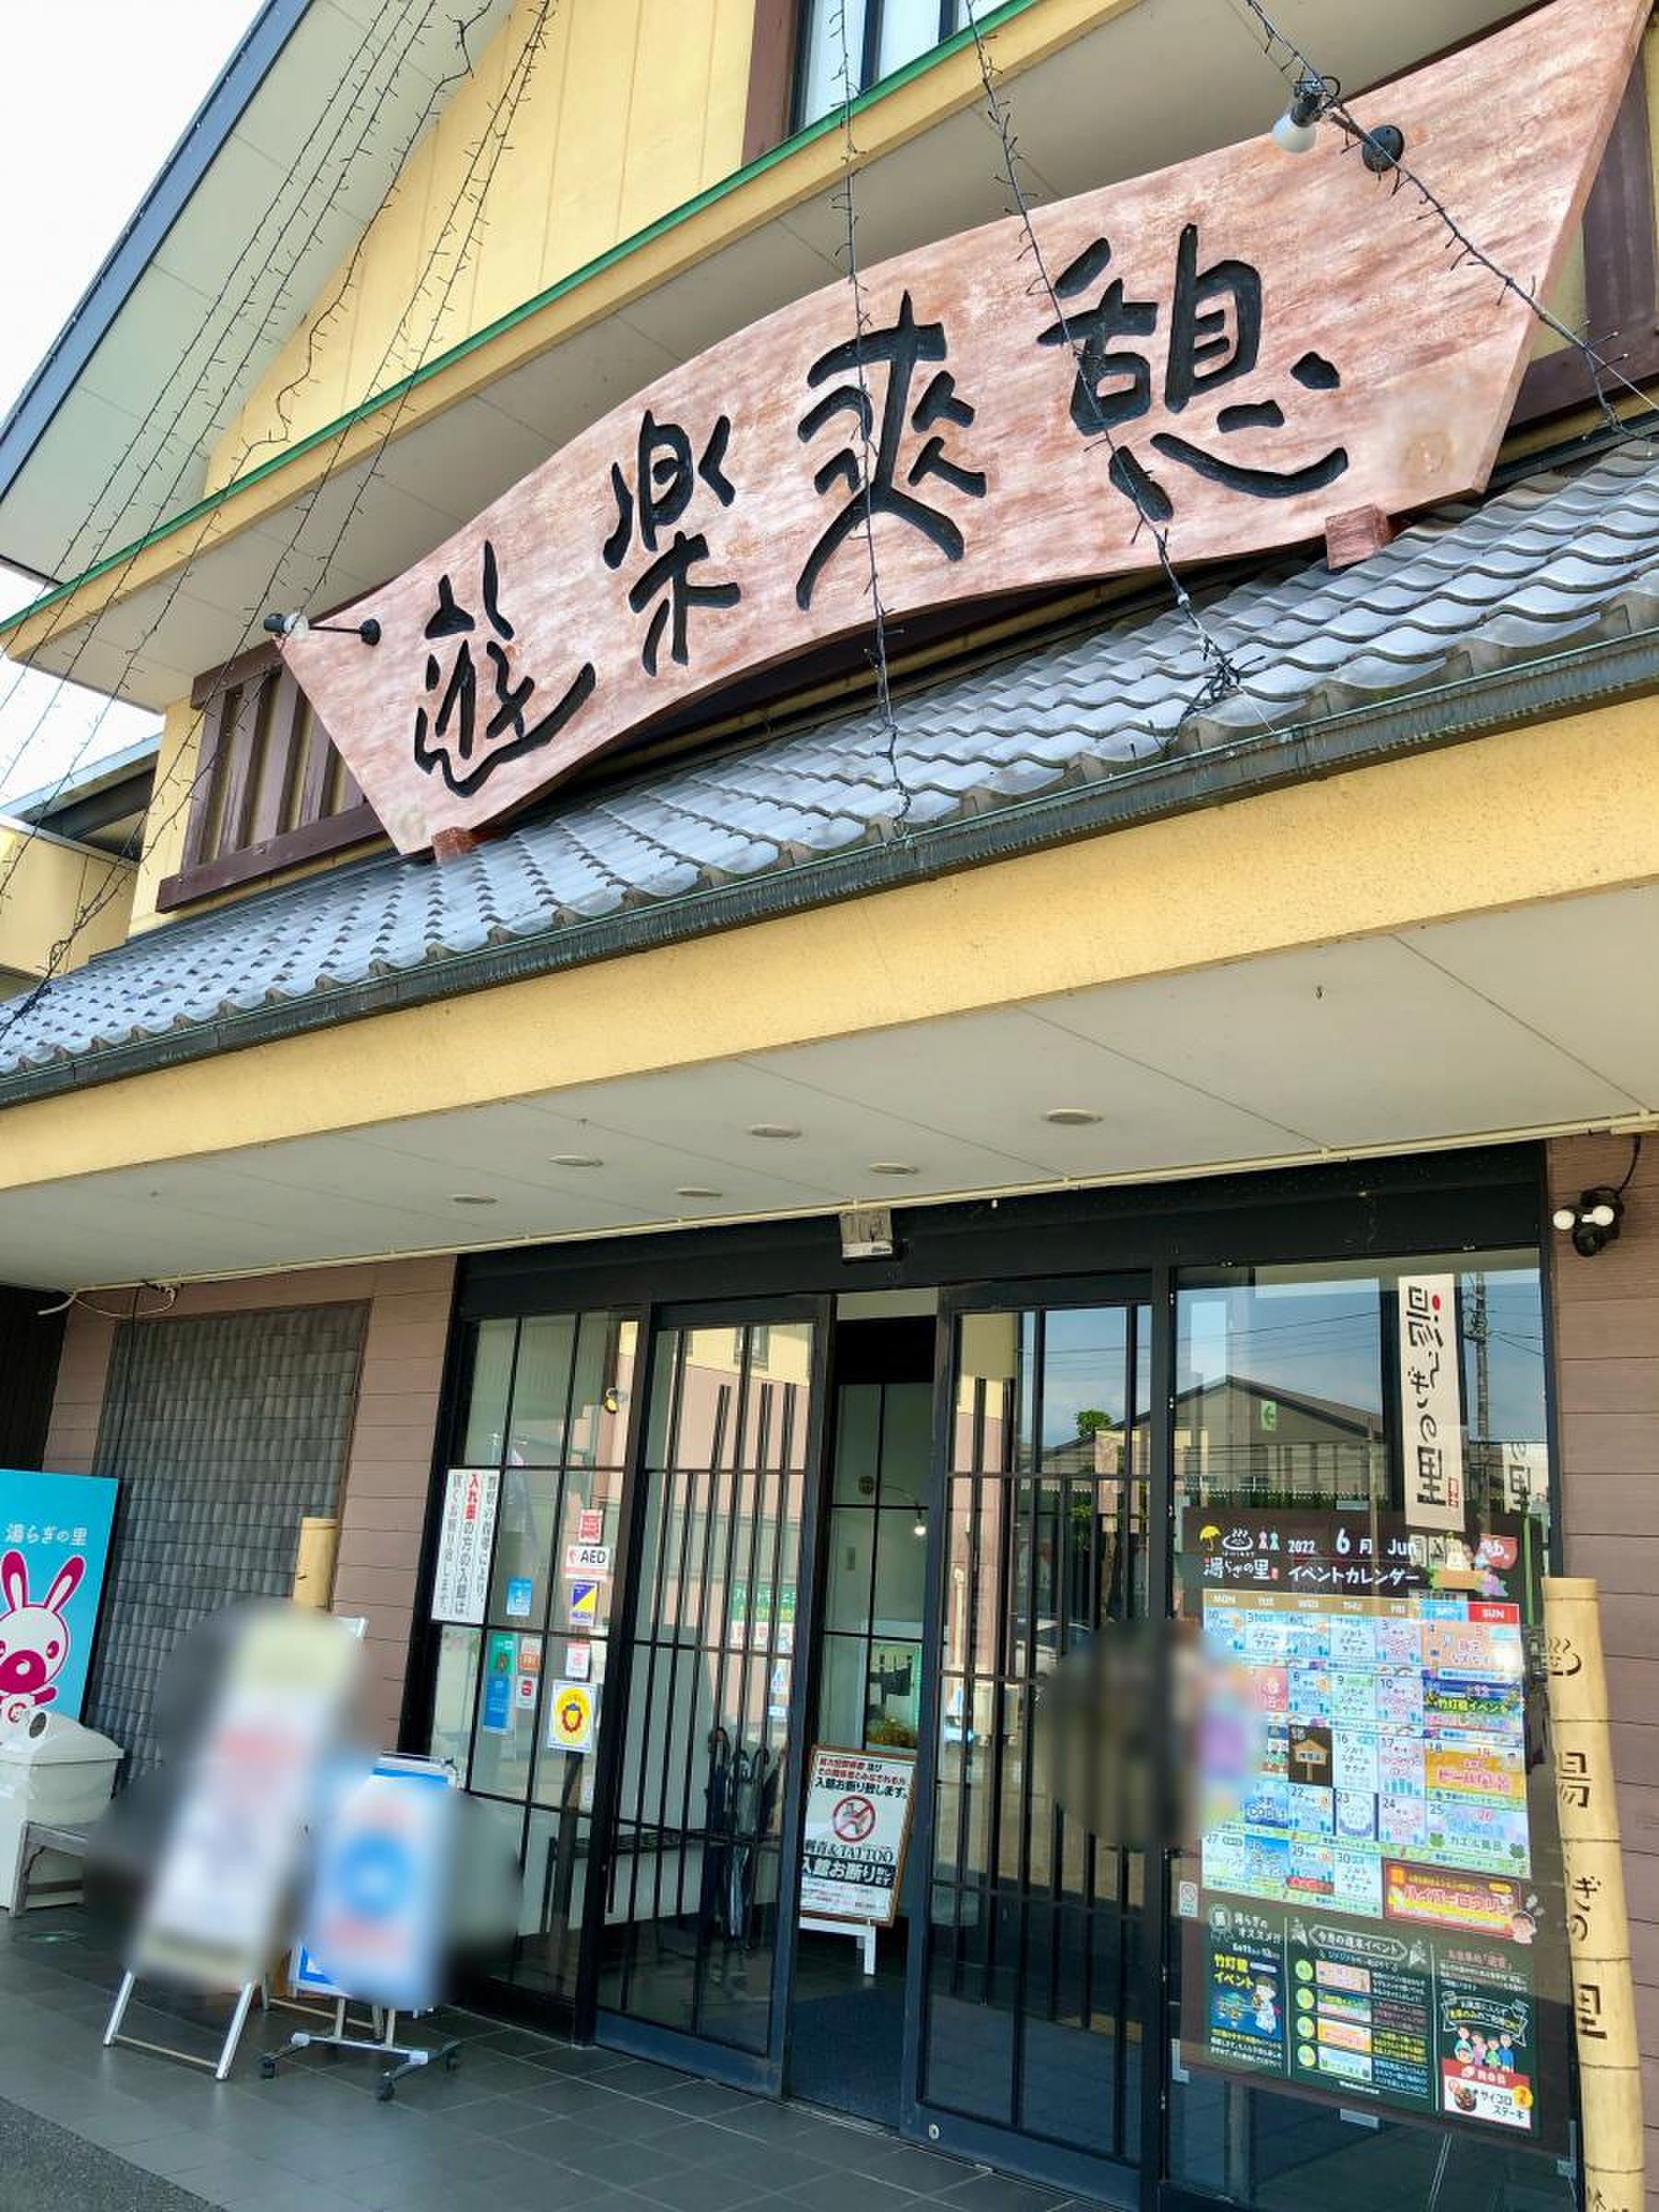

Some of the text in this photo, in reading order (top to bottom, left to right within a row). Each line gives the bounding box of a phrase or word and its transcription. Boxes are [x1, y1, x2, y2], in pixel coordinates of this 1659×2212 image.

[1288, 1539, 1315, 1554] 2022
[580, 1549, 606, 1564] AED
[1288, 1566, 1420, 1586] イベントカレンダー
[1430, 1804, 1444, 1816] 25
[1493, 2105, 1525, 2121] ステーキ
